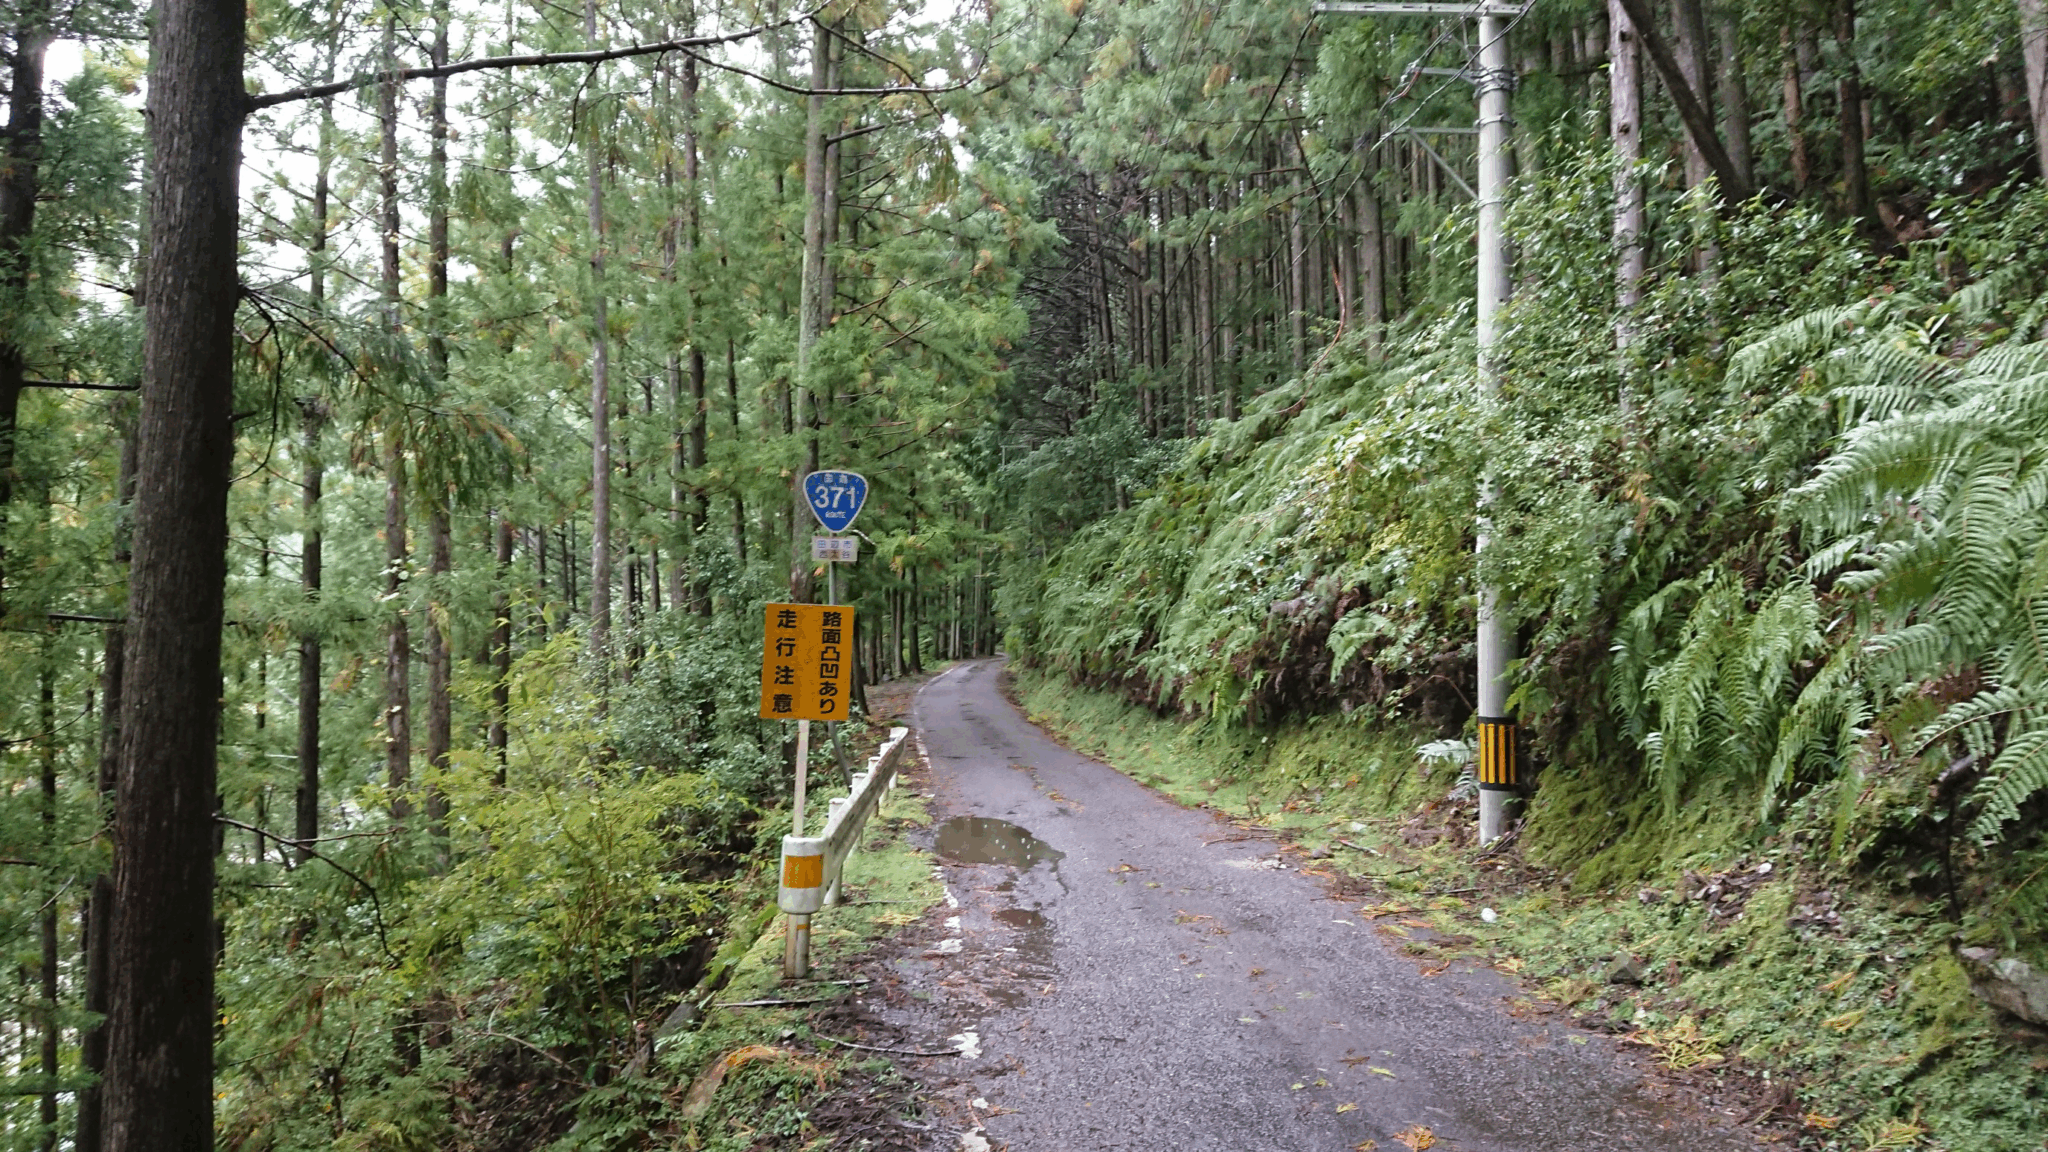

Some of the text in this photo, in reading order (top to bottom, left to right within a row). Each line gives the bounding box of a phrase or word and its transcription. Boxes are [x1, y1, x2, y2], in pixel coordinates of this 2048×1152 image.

[814, 486, 855, 509] 371
[772, 609, 797, 713] 走行注意
[816, 611, 842, 714] 路面凸凹あり
